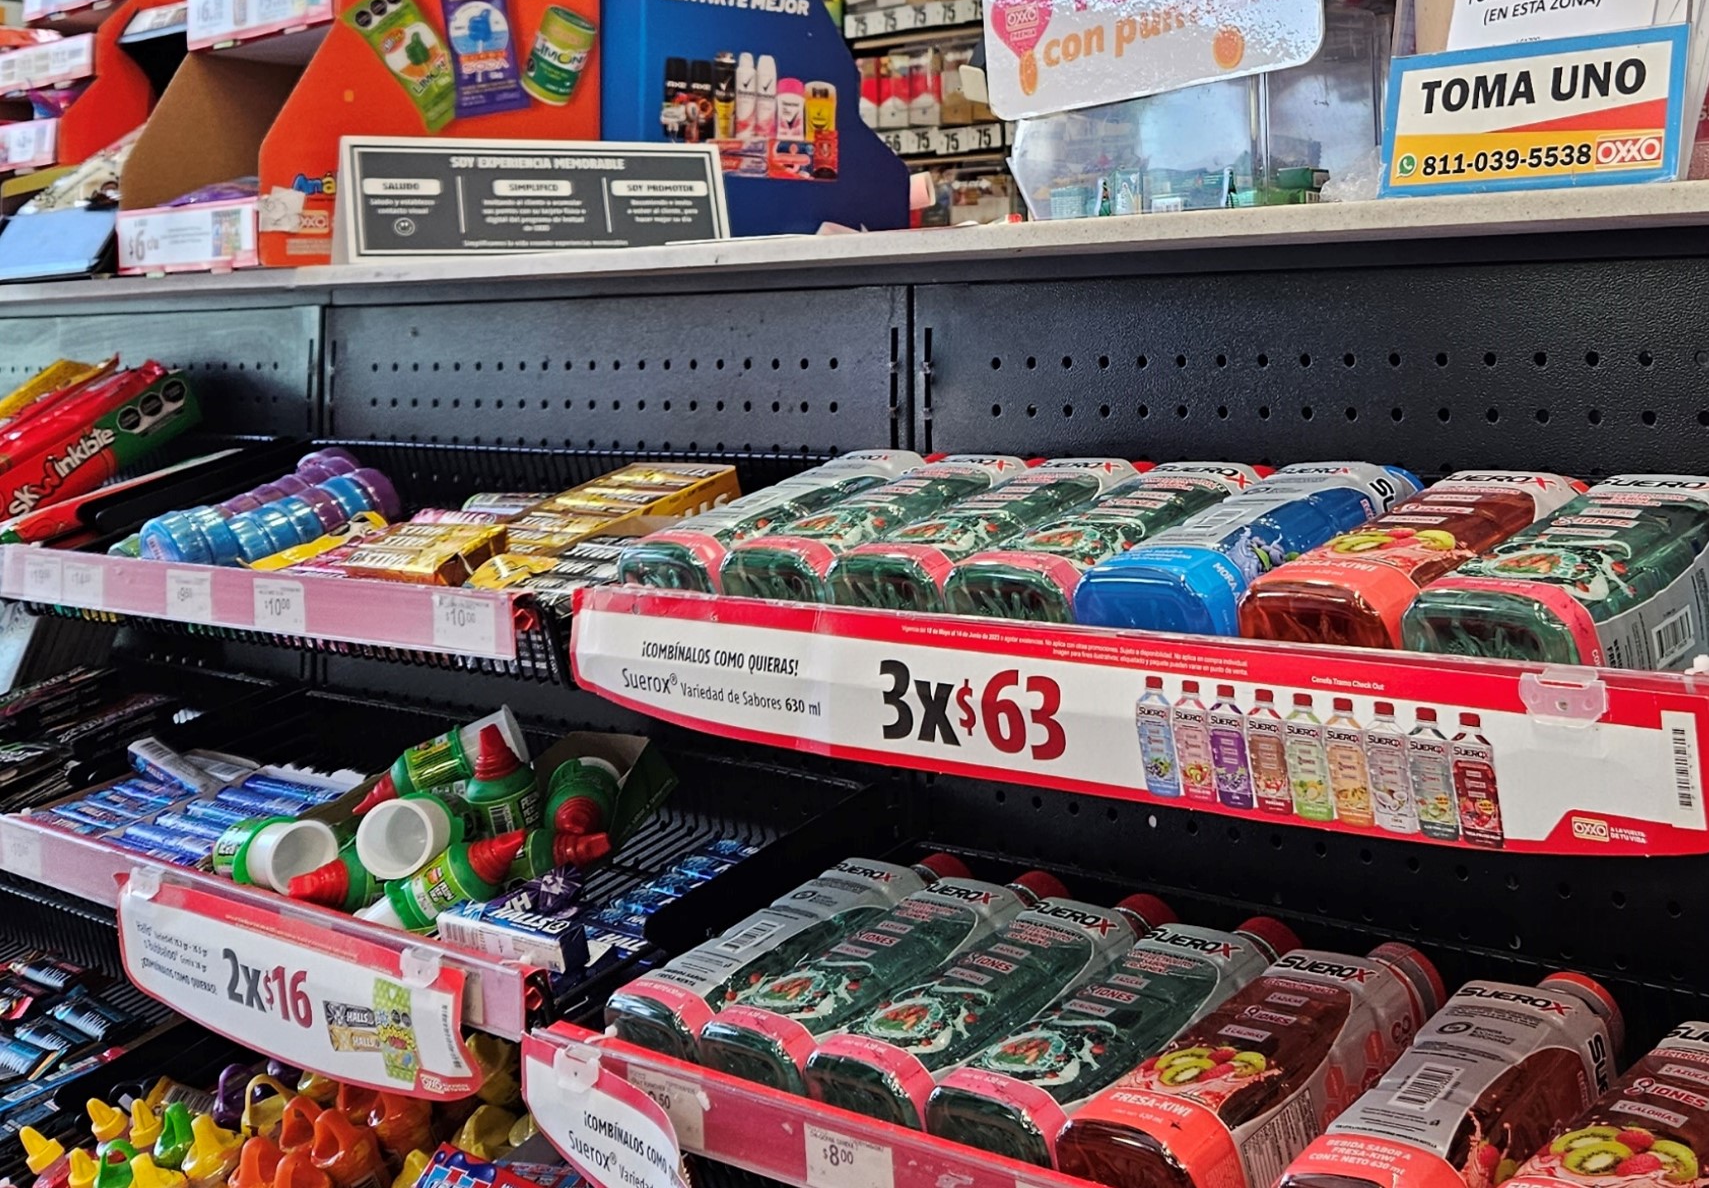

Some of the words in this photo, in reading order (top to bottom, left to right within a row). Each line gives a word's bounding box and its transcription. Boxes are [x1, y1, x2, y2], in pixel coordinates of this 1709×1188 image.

[1007, 7, 1038, 27] OXXO
[1483, 6, 1509, 26] (EN
[1512, 0, 1546, 18] ESTA
[1043, 23, 1105, 67] con
[1420, 69, 1536, 114] TOMA
[1550, 57, 1647, 102] UNO
[915, 131, 930, 150] 75
[944, 133, 960, 152] 75
[976, 128, 991, 147] 75
[450, 155, 475, 169] SOY
[477, 156, 552, 170] EXPERIENCIA
[554, 157, 626, 171] MEMORABLE
[1422, 143, 1592, 177] 811-039-5538
[1597, 136, 1662, 165] OXXO
[382, 182, 420, 191] SALUDO
[1154, 464, 1255, 491] SUEROX
[641, 641, 711, 665] ¡COMBÍNALOS
[714, 649, 745, 669] COMO
[748, 654, 799, 676] QUIERAS!
[681, 682, 725, 703] Variedad
[727, 689, 740, 705] de
[742, 691, 782, 711] Sabores
[785, 697, 805, 713] 630
[808, 701, 821, 716] ml
[1574, 822, 1607, 837] OXXO
[1026, 901, 1119, 938] SUEROX
[1144, 927, 1245, 960] SUEROX
[976, 955, 1013, 972] IONES
[1274, 955, 1377, 984] SUEROX
[1096, 986, 1135, 1002] IONES
[1456, 986, 1577, 1017] SUEROX
[346, 1011, 368, 1023] HALLS
[1109, 1090, 1193, 1118] FRESA-KIWI
[1651, 1086, 1709, 1109] IONES
[583, 1111, 645, 1156] ¡COMBÍNALOS
[646, 1145, 668, 1174] COMO
[1326, 1139, 1364, 1150] BEBIDA
[1366, 1143, 1403, 1157] SABOR
[1331, 1147, 1396, 1163] FRESA-KIWI
[1309, 1152, 1339, 1162] CONT.
[1340, 1155, 1369, 1166] NETO
[1369, 1160, 1390, 1171] 630
